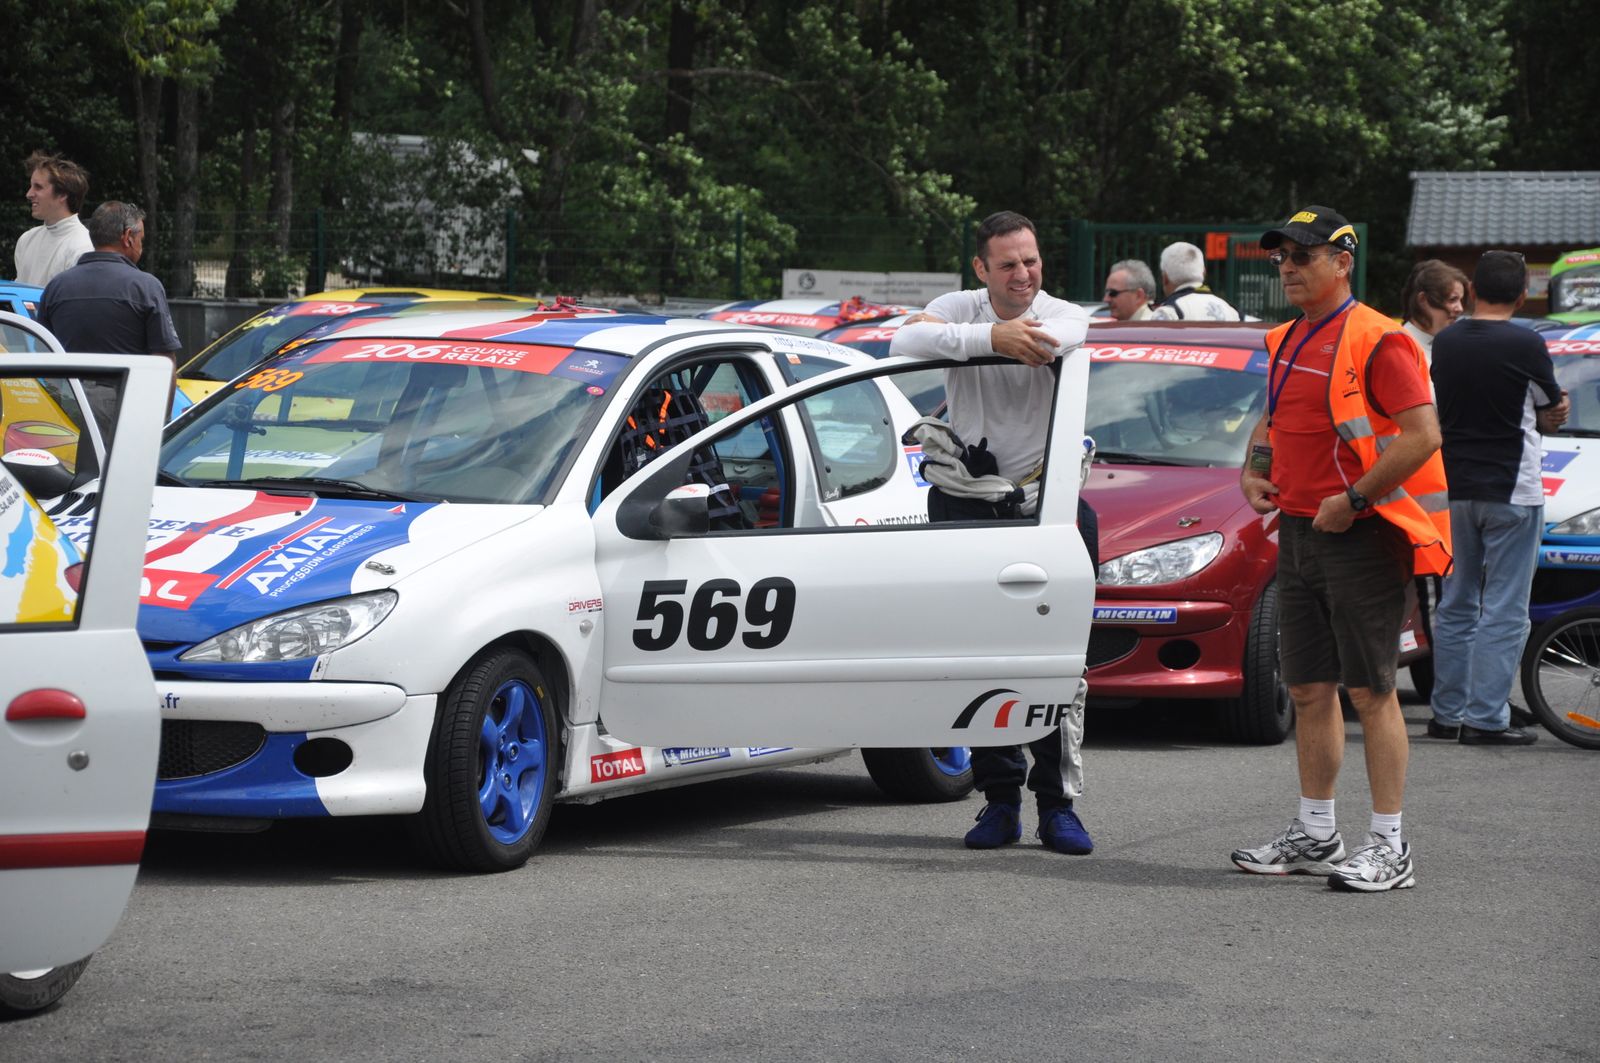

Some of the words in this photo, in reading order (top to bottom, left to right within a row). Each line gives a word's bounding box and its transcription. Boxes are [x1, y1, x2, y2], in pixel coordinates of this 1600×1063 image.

[343, 344, 450, 360] 206
[441, 352, 521, 366] RELAIS
[450, 346, 529, 358] COURSE
[1086, 347, 1153, 360] 06
[1149, 353, 1217, 365] RELAIS
[1151, 348, 1220, 358] COURSE
[234, 368, 304, 392] 569
[246, 523, 363, 595] AXIAL
[269, 553, 324, 598] PROFESSION
[322, 524, 376, 558] CARROSSIER
[568, 598, 603, 612] DRIVERS
[632, 576, 796, 651] 569
[1095, 608, 1172, 620] MICHELIN
[592, 755, 643, 778] TOTAL
